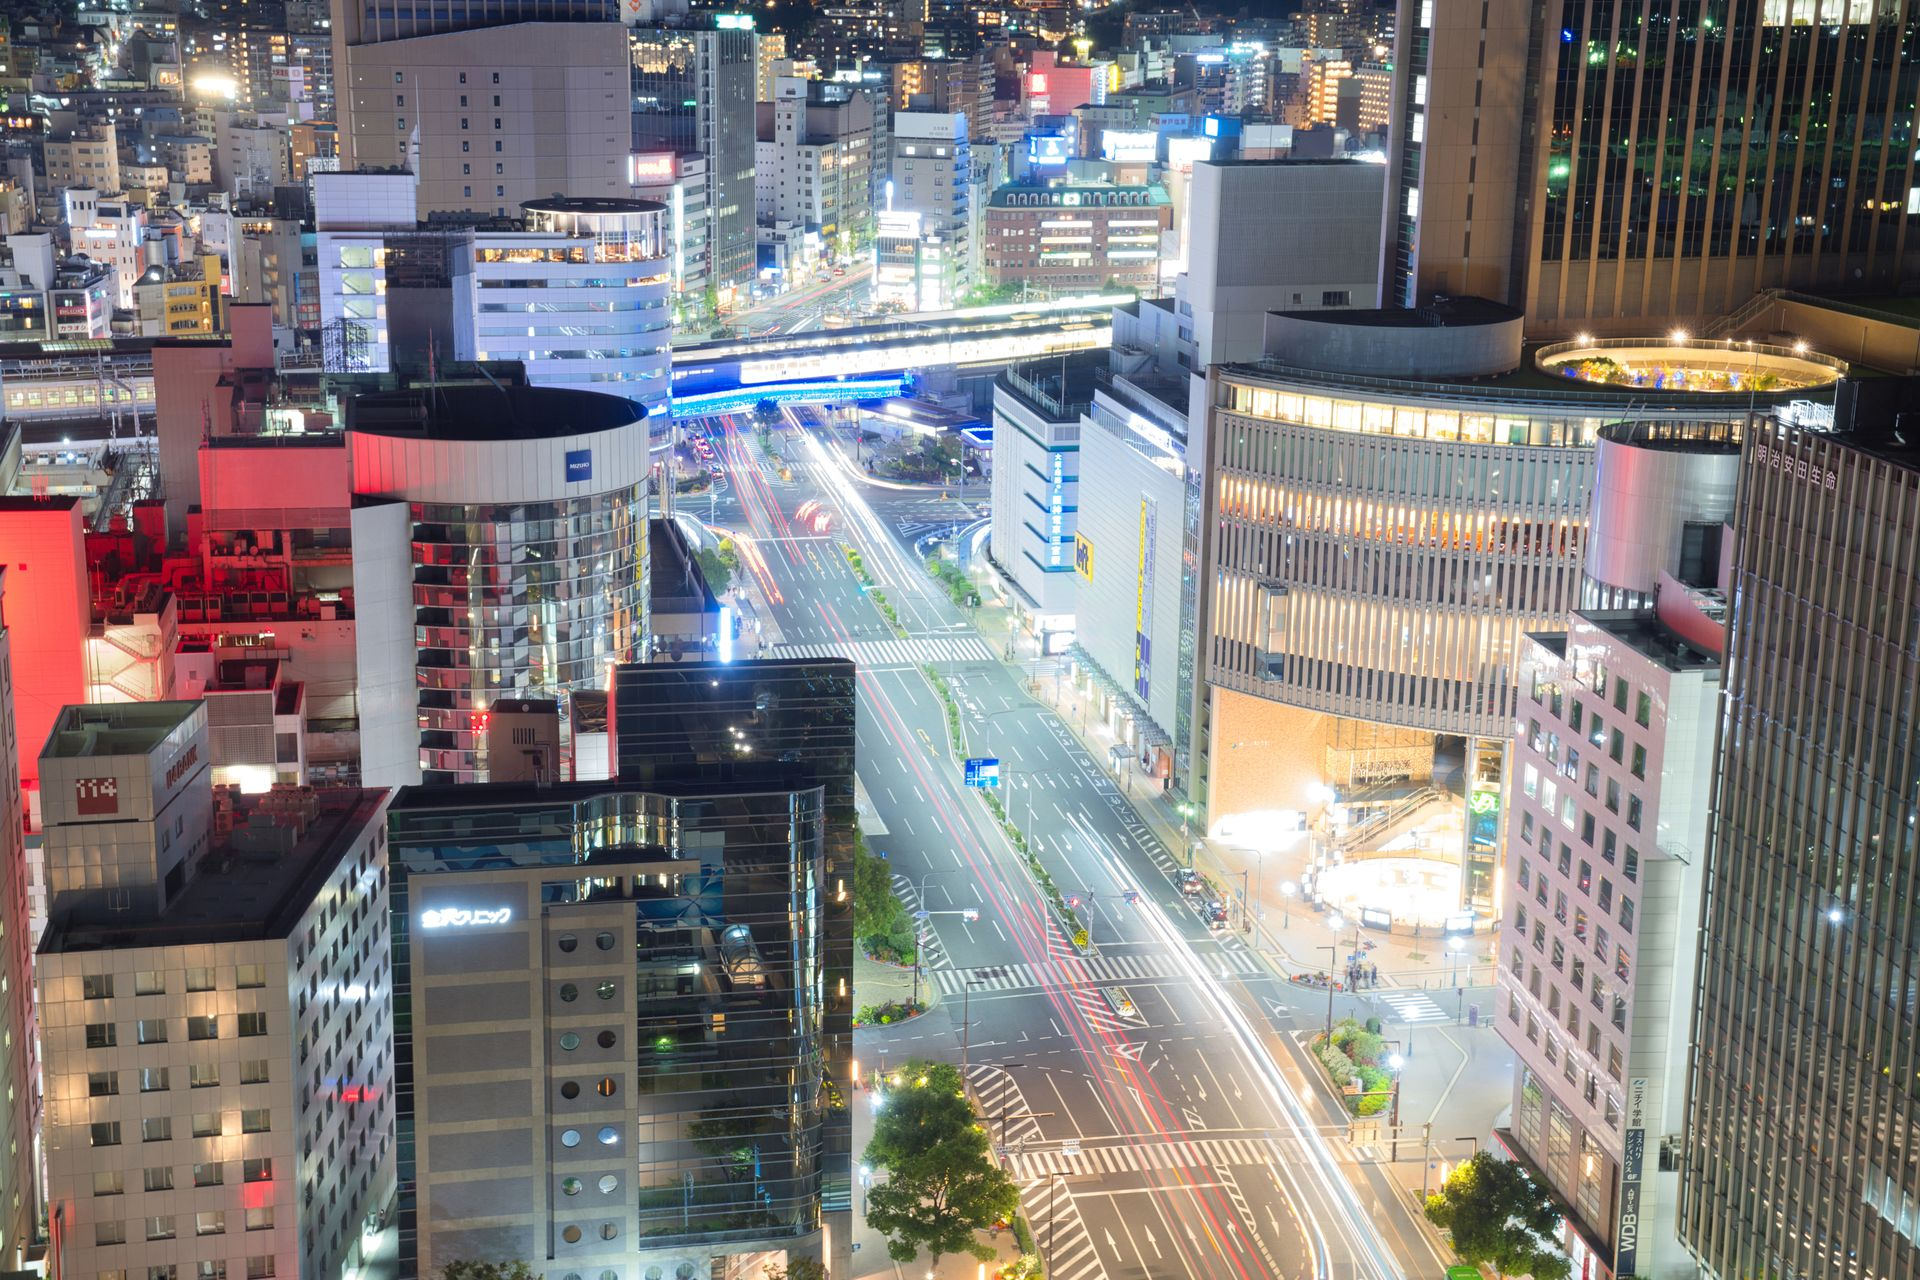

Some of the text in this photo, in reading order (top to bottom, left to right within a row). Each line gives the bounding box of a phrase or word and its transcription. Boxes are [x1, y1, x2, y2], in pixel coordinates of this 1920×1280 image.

[1757, 444, 1836, 490] 明治安田生命
[76, 778, 117, 799] 114
[1632, 1087, 1643, 1127] ニチイ学館
[1620, 1214, 1636, 1252] WDB
